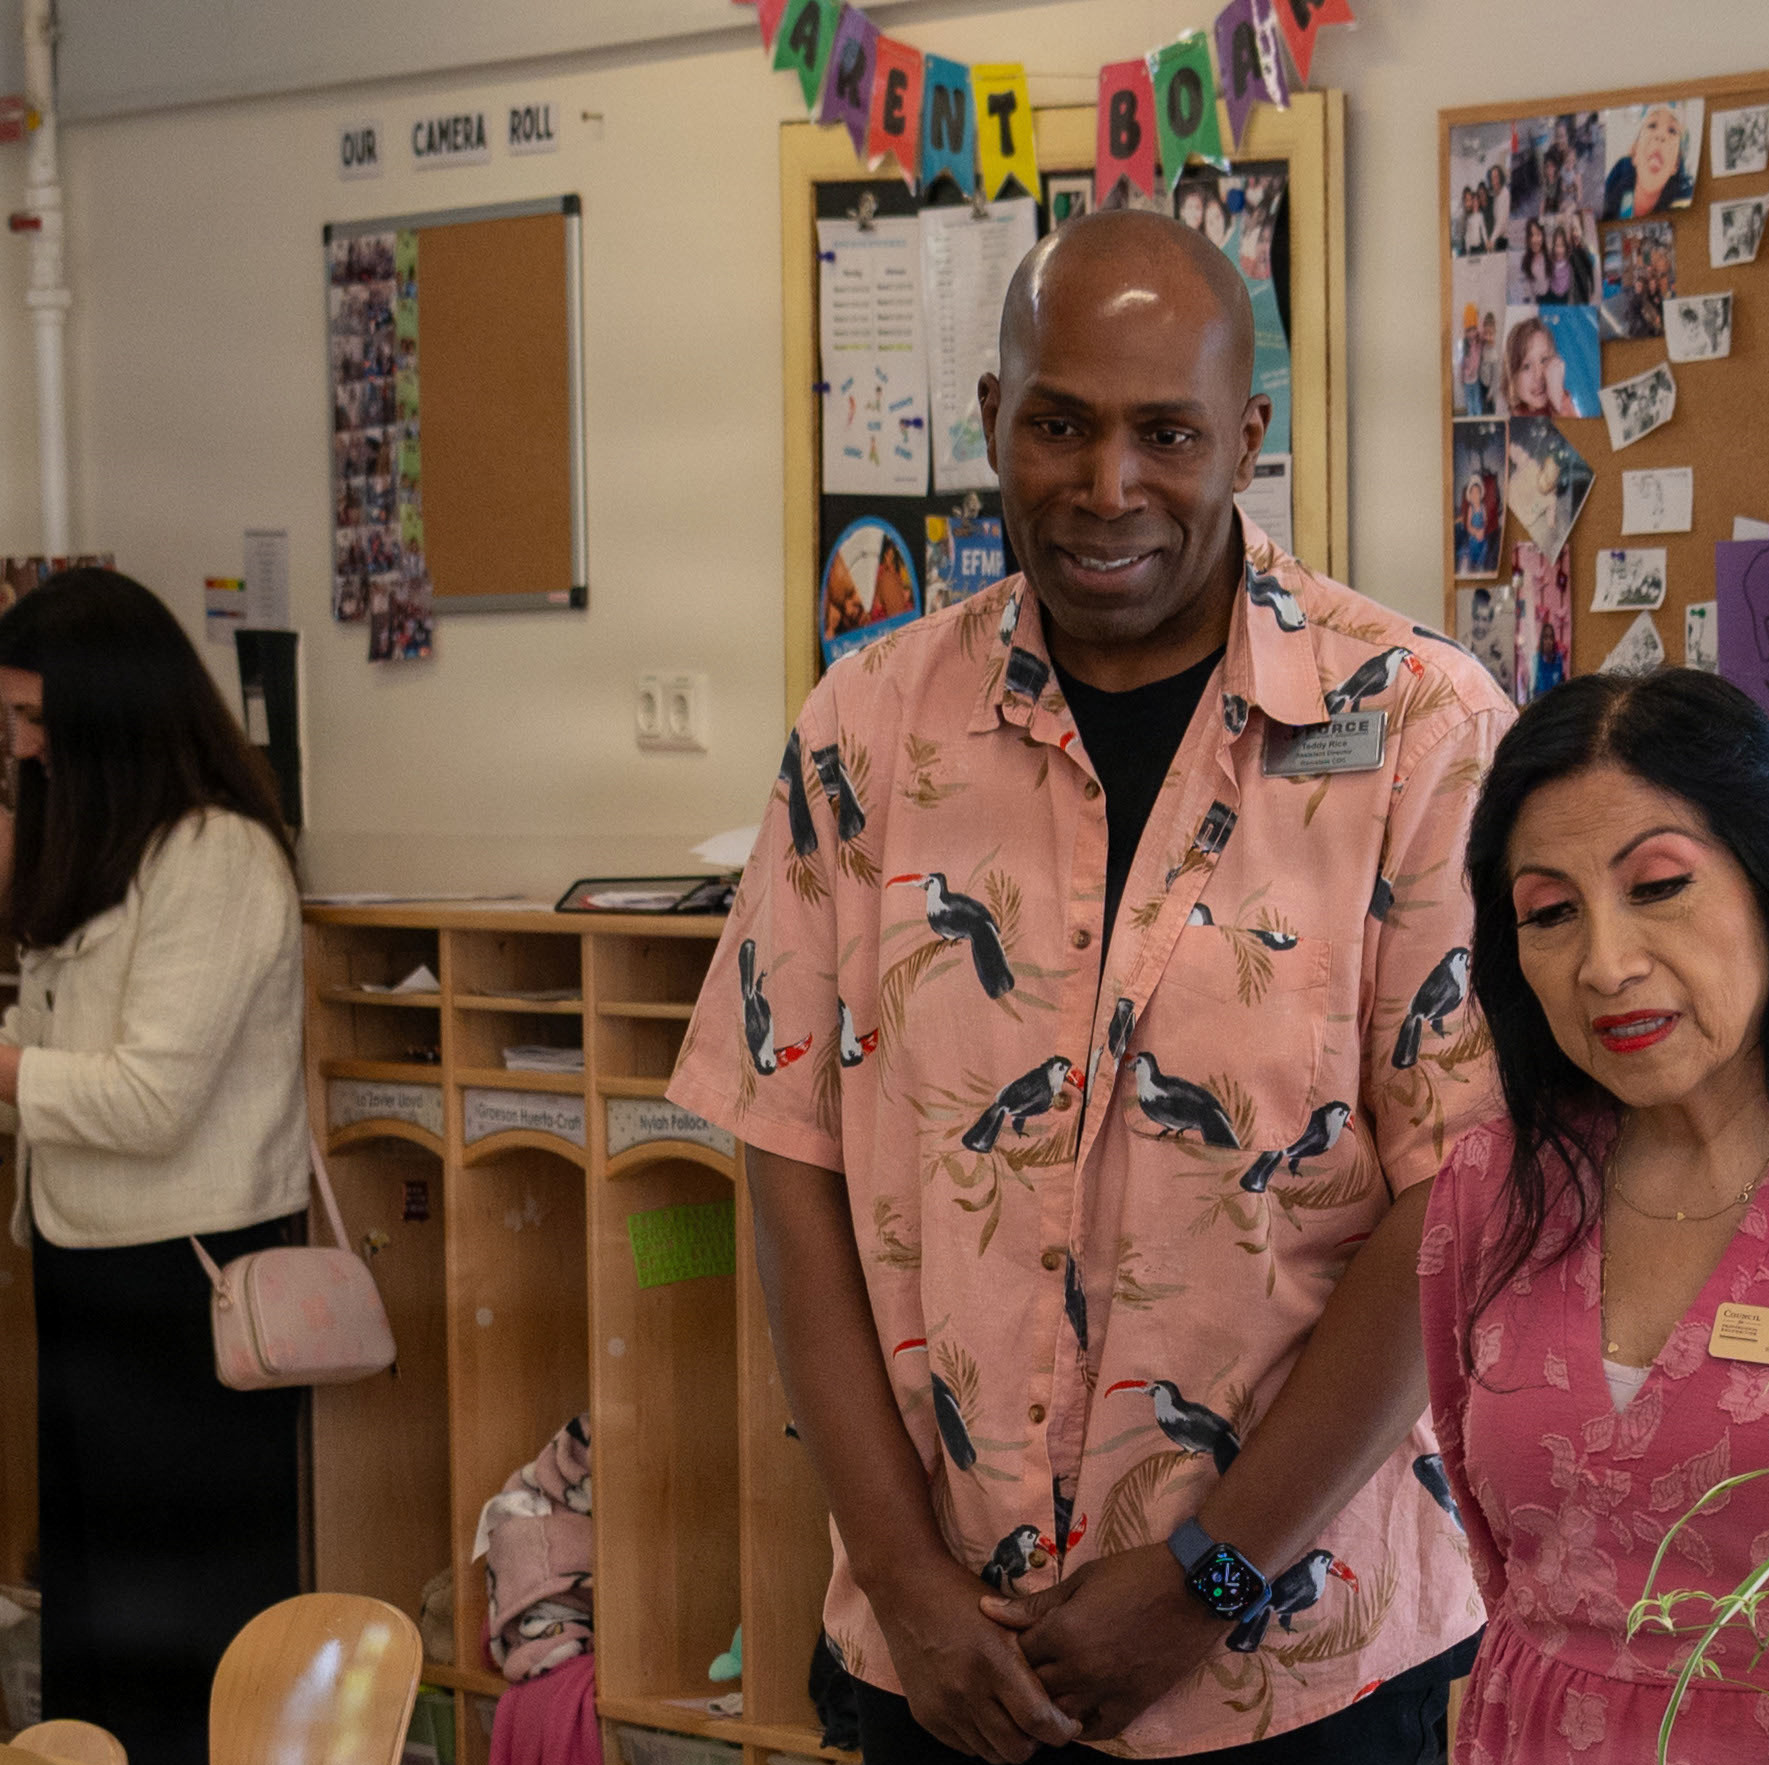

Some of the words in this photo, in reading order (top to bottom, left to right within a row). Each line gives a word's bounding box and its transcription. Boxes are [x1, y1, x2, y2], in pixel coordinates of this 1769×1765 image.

[790, 0, 1018, 158] ARENT
[341, 128, 377, 167] OUR
[413, 112, 487, 157] CAMERA
[509, 105, 554, 145] ROLL
